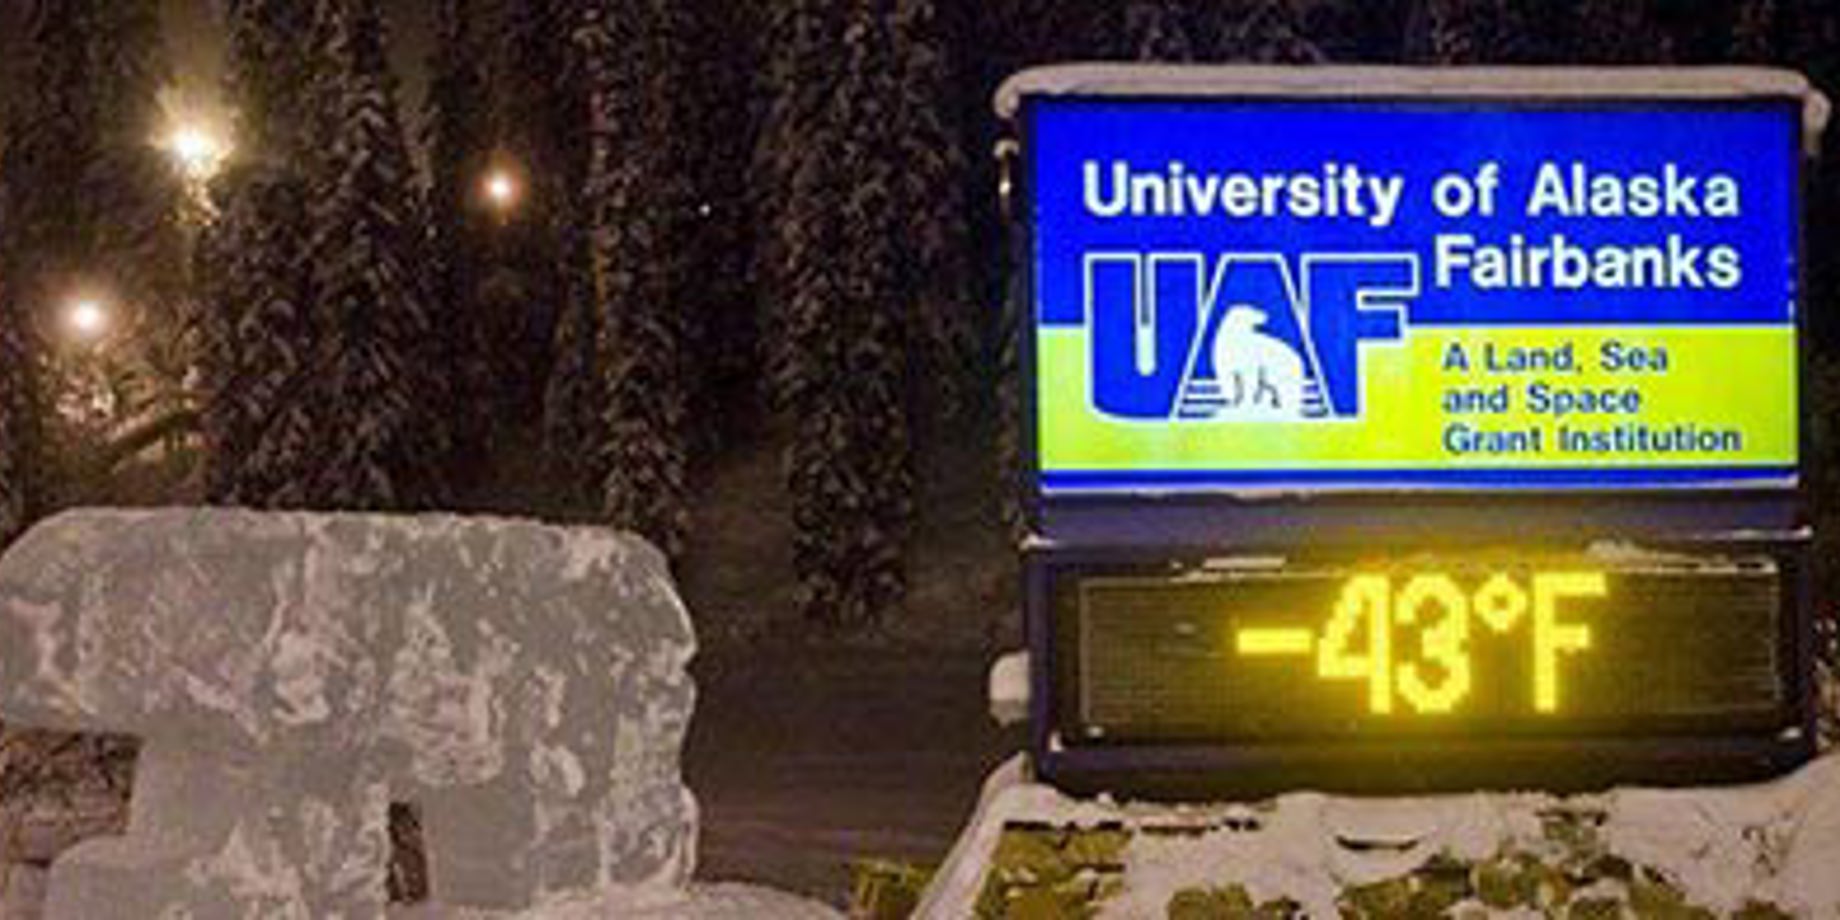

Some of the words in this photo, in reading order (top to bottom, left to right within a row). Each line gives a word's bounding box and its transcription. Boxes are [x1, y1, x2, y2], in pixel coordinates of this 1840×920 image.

[1082, 161, 1404, 227] University
[1432, 164, 1501, 218] of
[1525, 163, 1739, 218] Alaska
[1434, 235, 1742, 289] Fairbanks
[1084, 252, 1420, 421] UAF
[1442, 342, 1470, 371] A
[1600, 339, 1668, 372] Sea
[1442, 383, 1509, 414] and
[1526, 381, 1641, 417] Space
[1442, 423, 1543, 455] Grant
[1558, 423, 1742, 453] Institution
